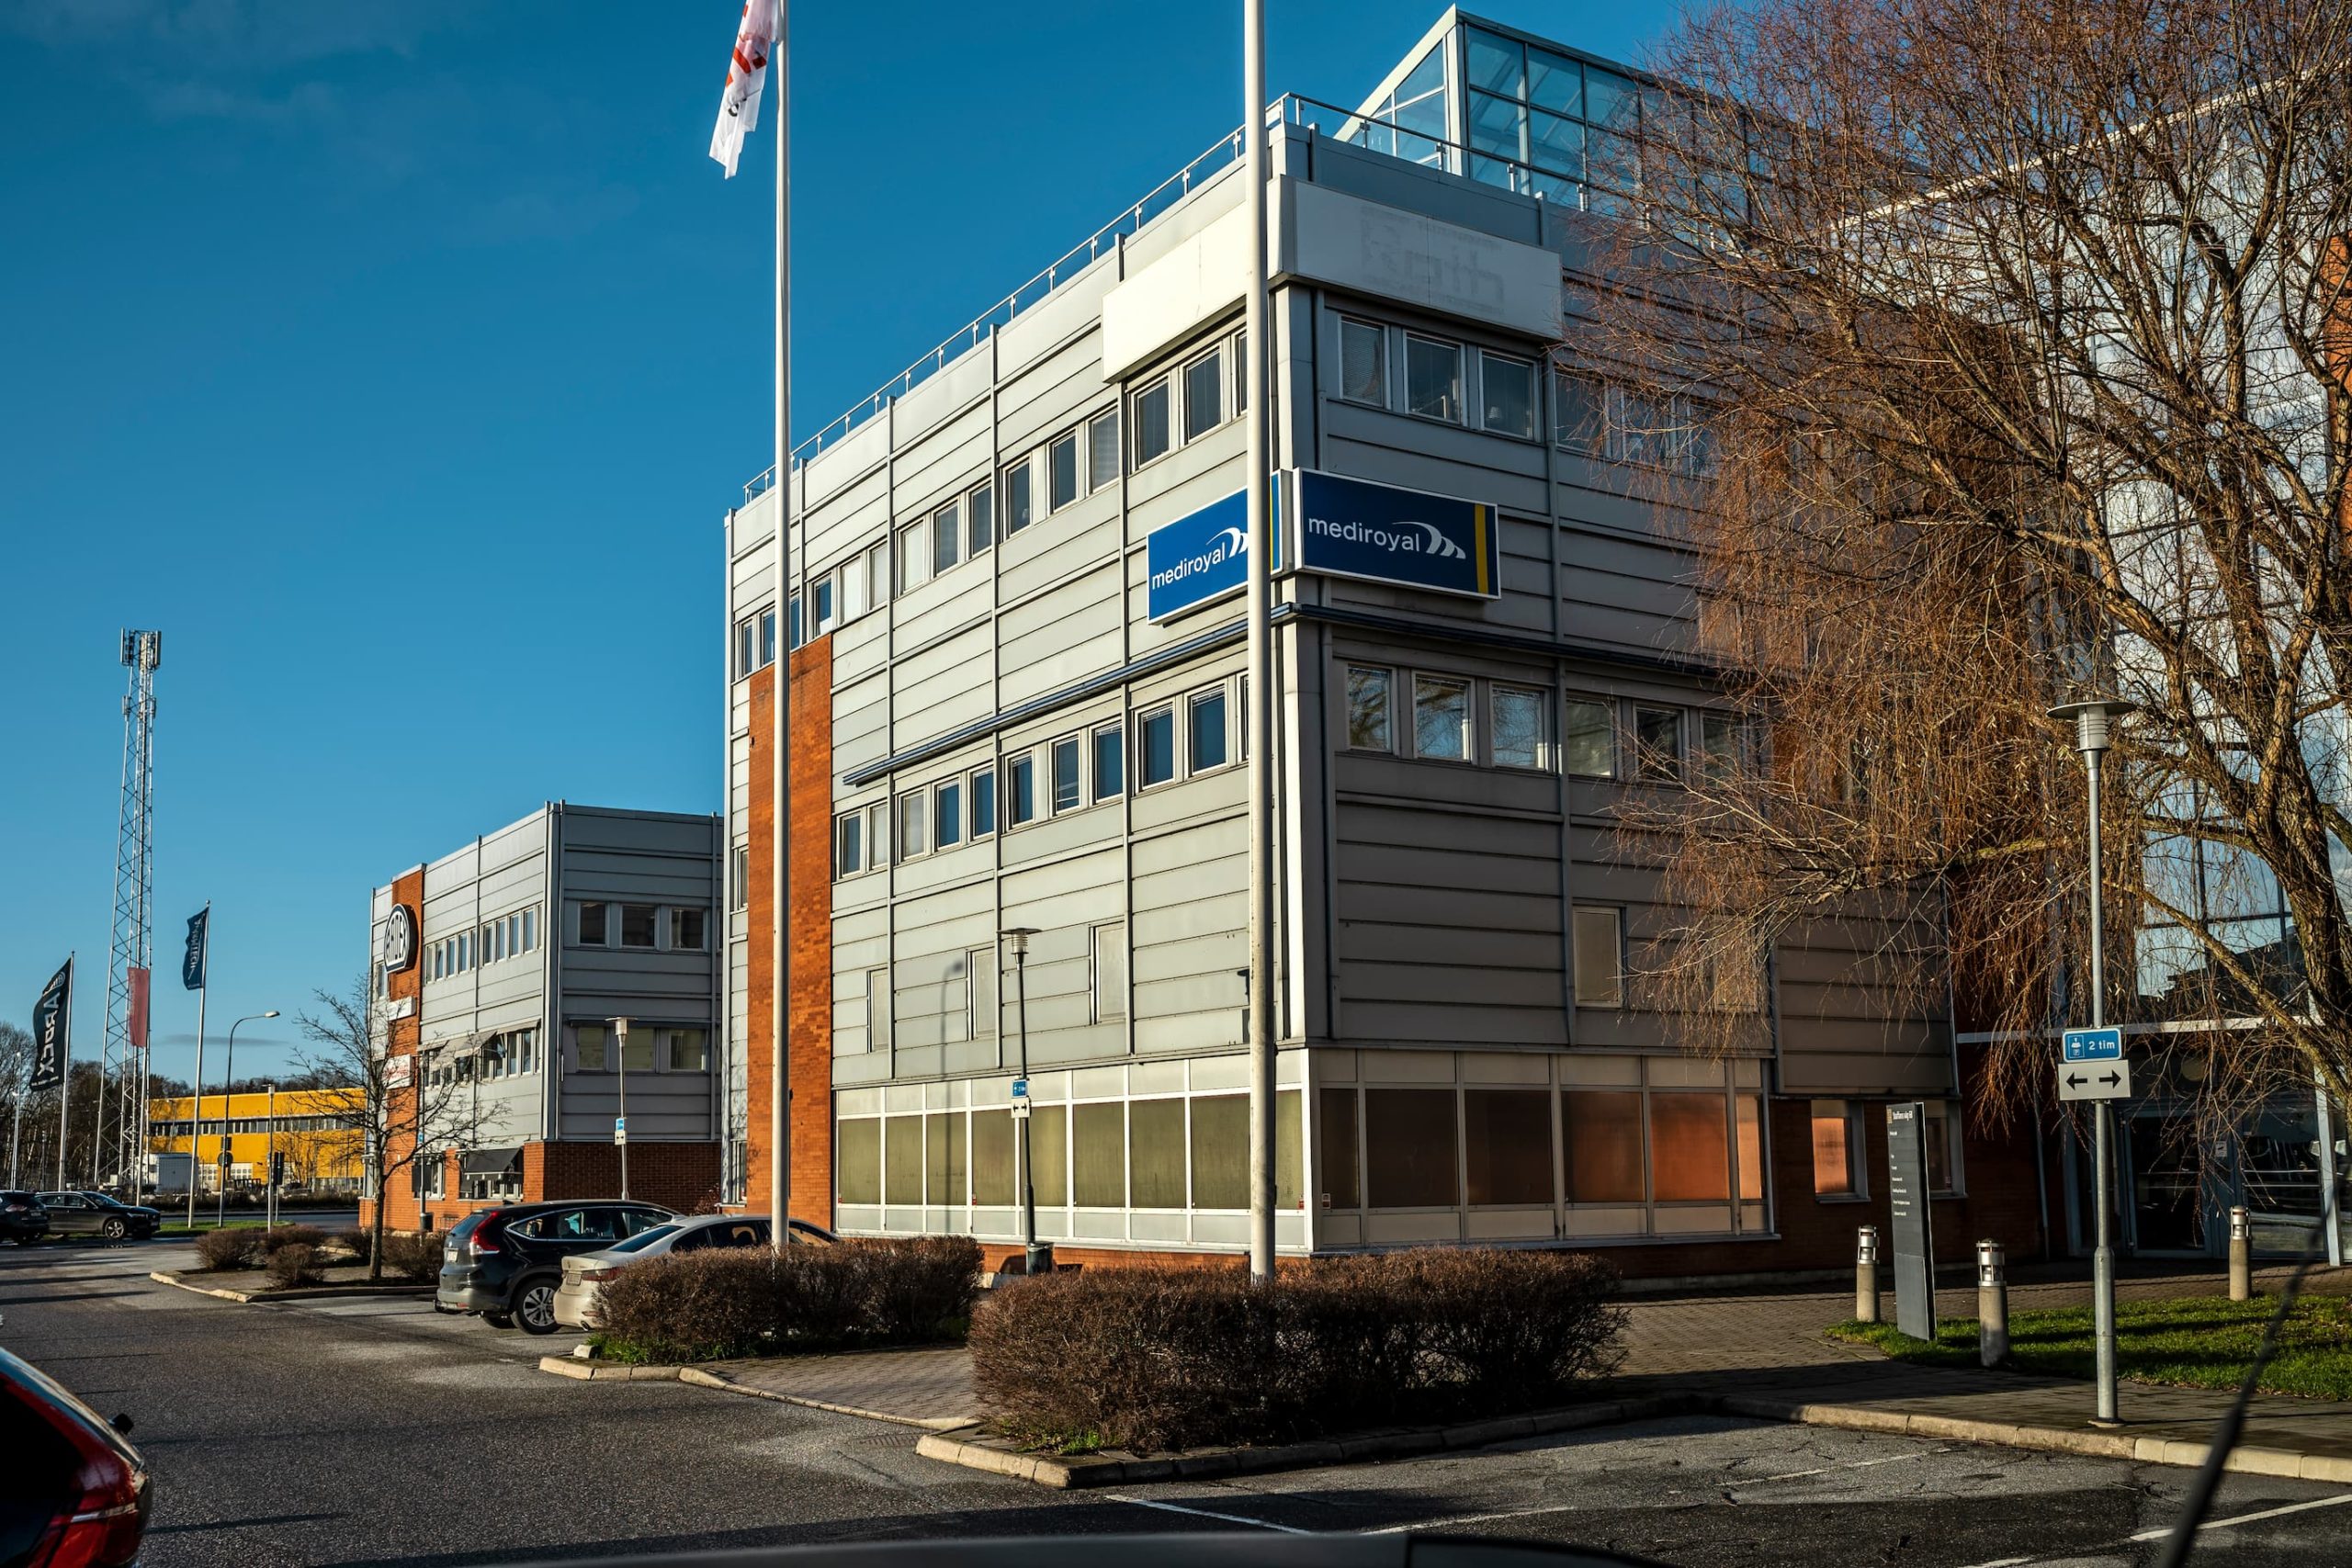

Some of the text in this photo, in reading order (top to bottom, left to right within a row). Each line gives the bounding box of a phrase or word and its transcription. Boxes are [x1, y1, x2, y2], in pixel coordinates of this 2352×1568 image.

[1308, 517, 1420, 552] mediroyal
[1151, 542, 1226, 591] mediroyal
[2088, 1040, 2115, 1051] 2 tim
